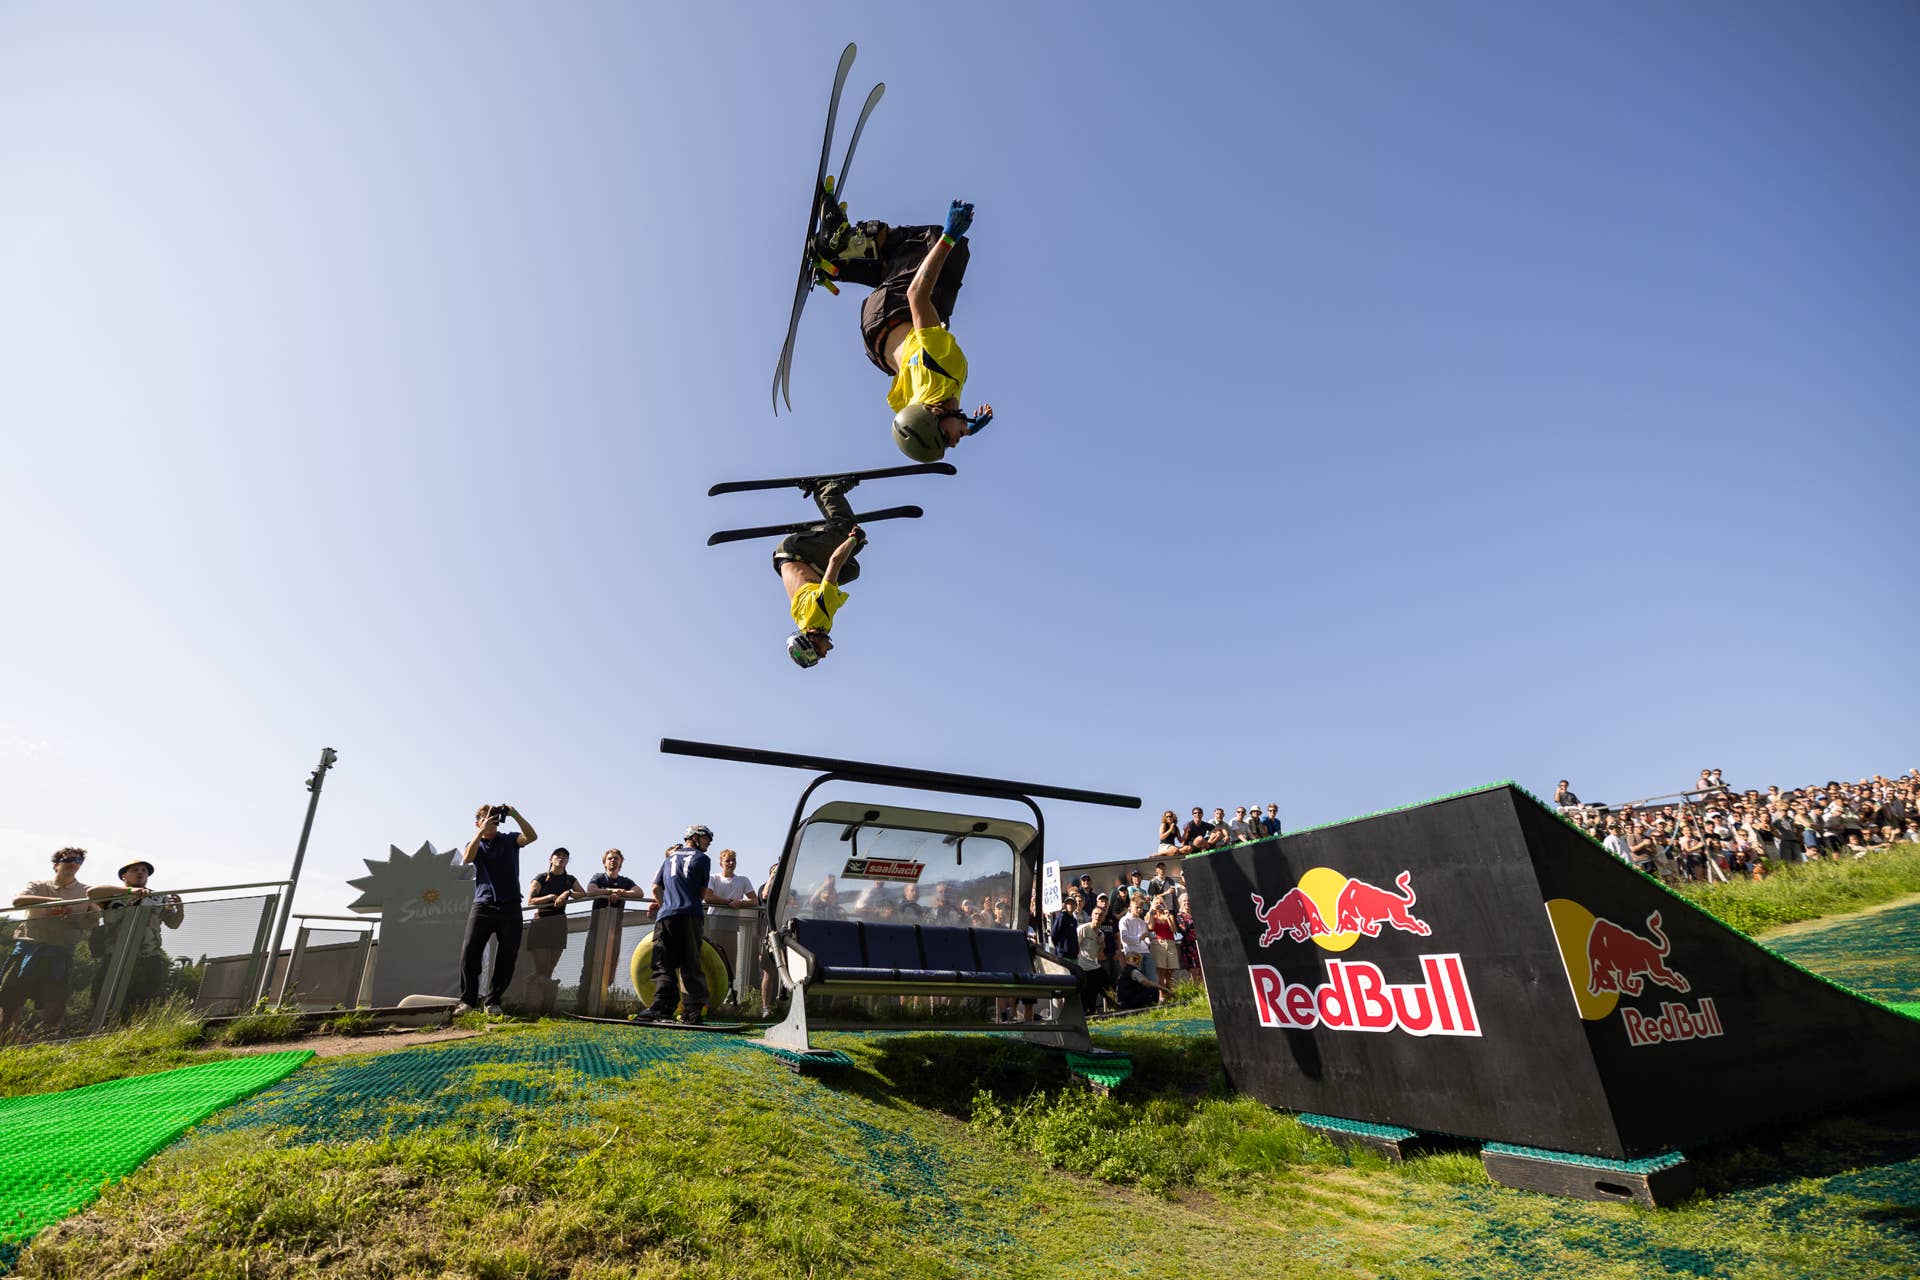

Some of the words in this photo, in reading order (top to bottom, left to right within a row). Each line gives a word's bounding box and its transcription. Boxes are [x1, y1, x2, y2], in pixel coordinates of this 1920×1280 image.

[669, 855, 693, 878] 11
[868, 862, 919, 876] saalbach
[1250, 956, 1478, 1033] RedBull
[1622, 999, 1723, 1045] RedBull
